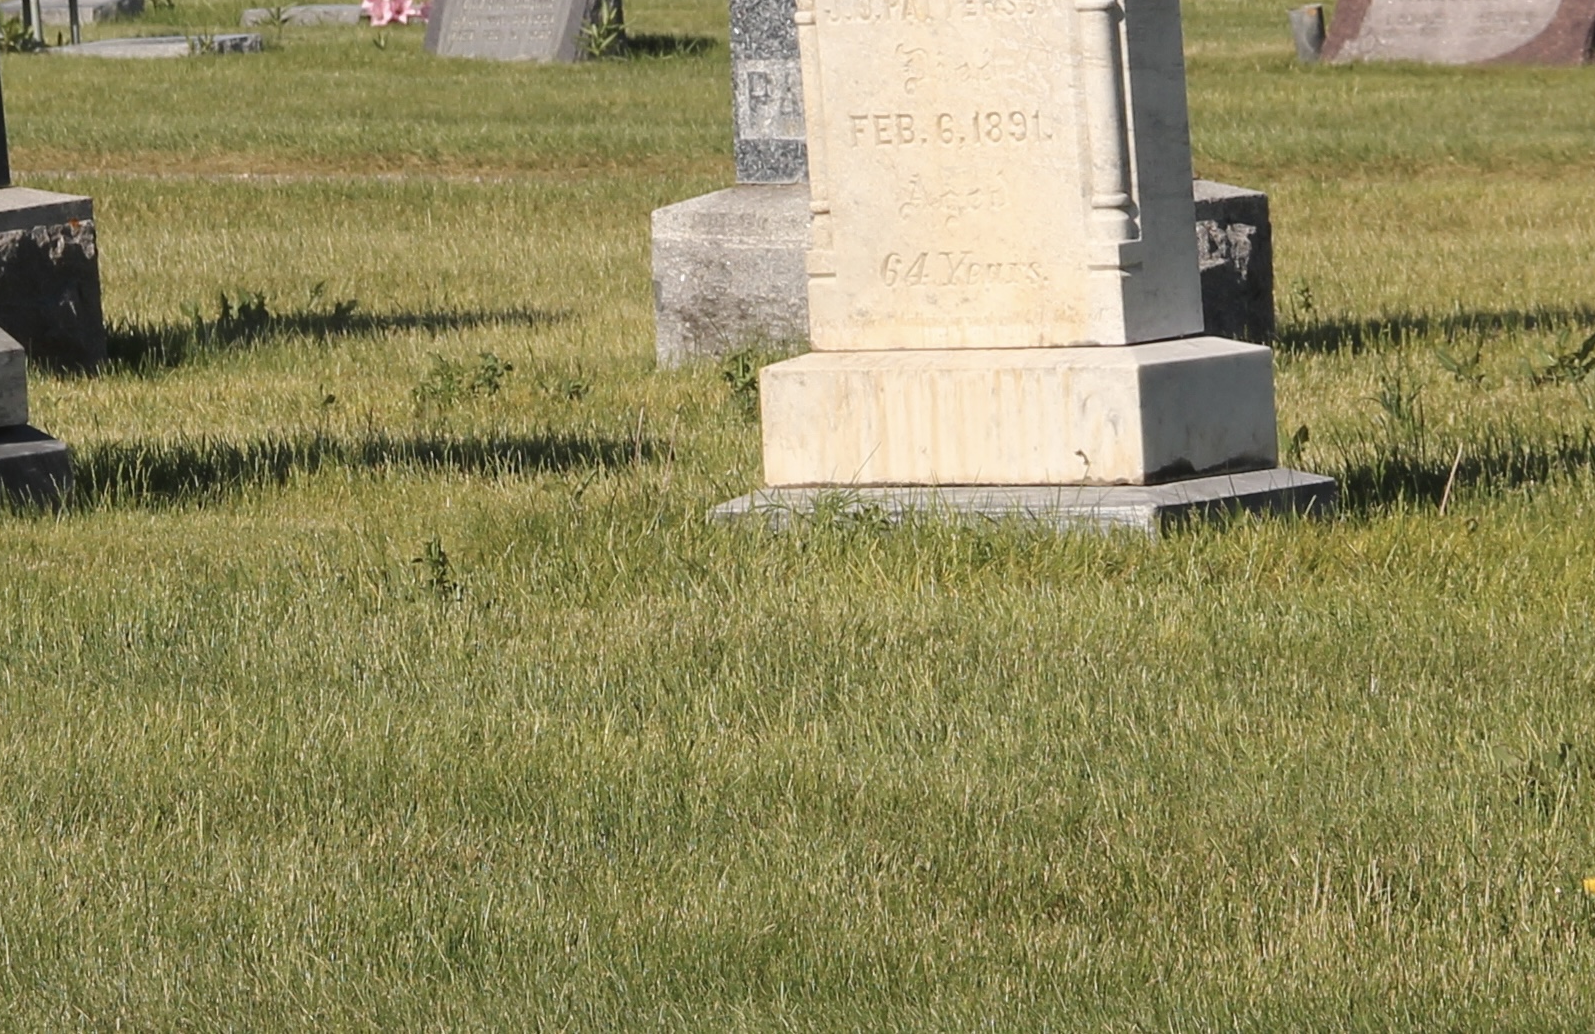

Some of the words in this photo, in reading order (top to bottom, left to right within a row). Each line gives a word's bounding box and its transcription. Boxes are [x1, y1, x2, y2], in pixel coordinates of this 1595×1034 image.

[849, 113, 928, 148] FEB.
[972, 109, 1054, 145] 1891.
[879, 250, 930, 288] 64
